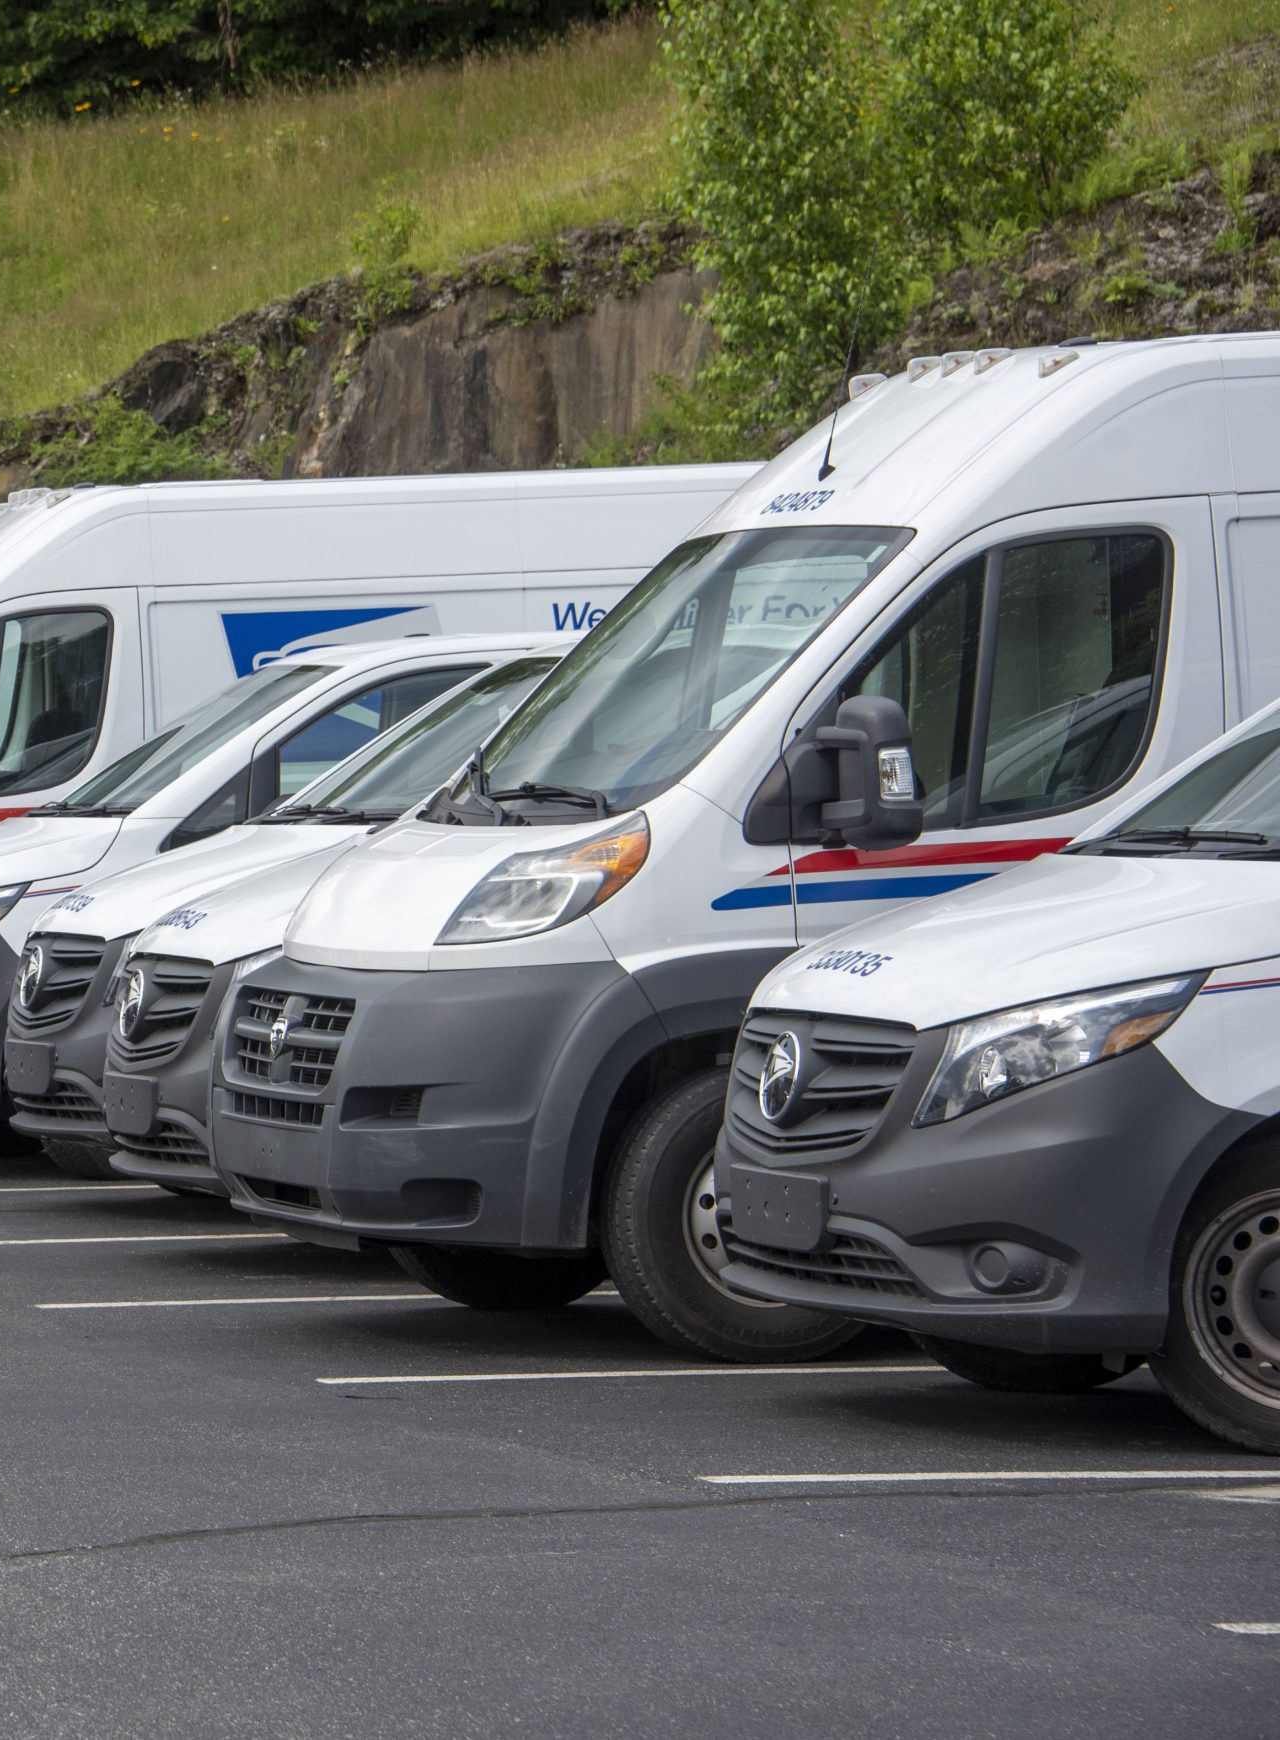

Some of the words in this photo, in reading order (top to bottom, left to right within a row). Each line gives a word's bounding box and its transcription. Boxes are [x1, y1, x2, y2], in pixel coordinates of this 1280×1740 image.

[761, 489, 835, 515] 8424879
[552, 601, 607, 631] We
[761, 595, 826, 622] For
[806, 950, 893, 976] 3330135
